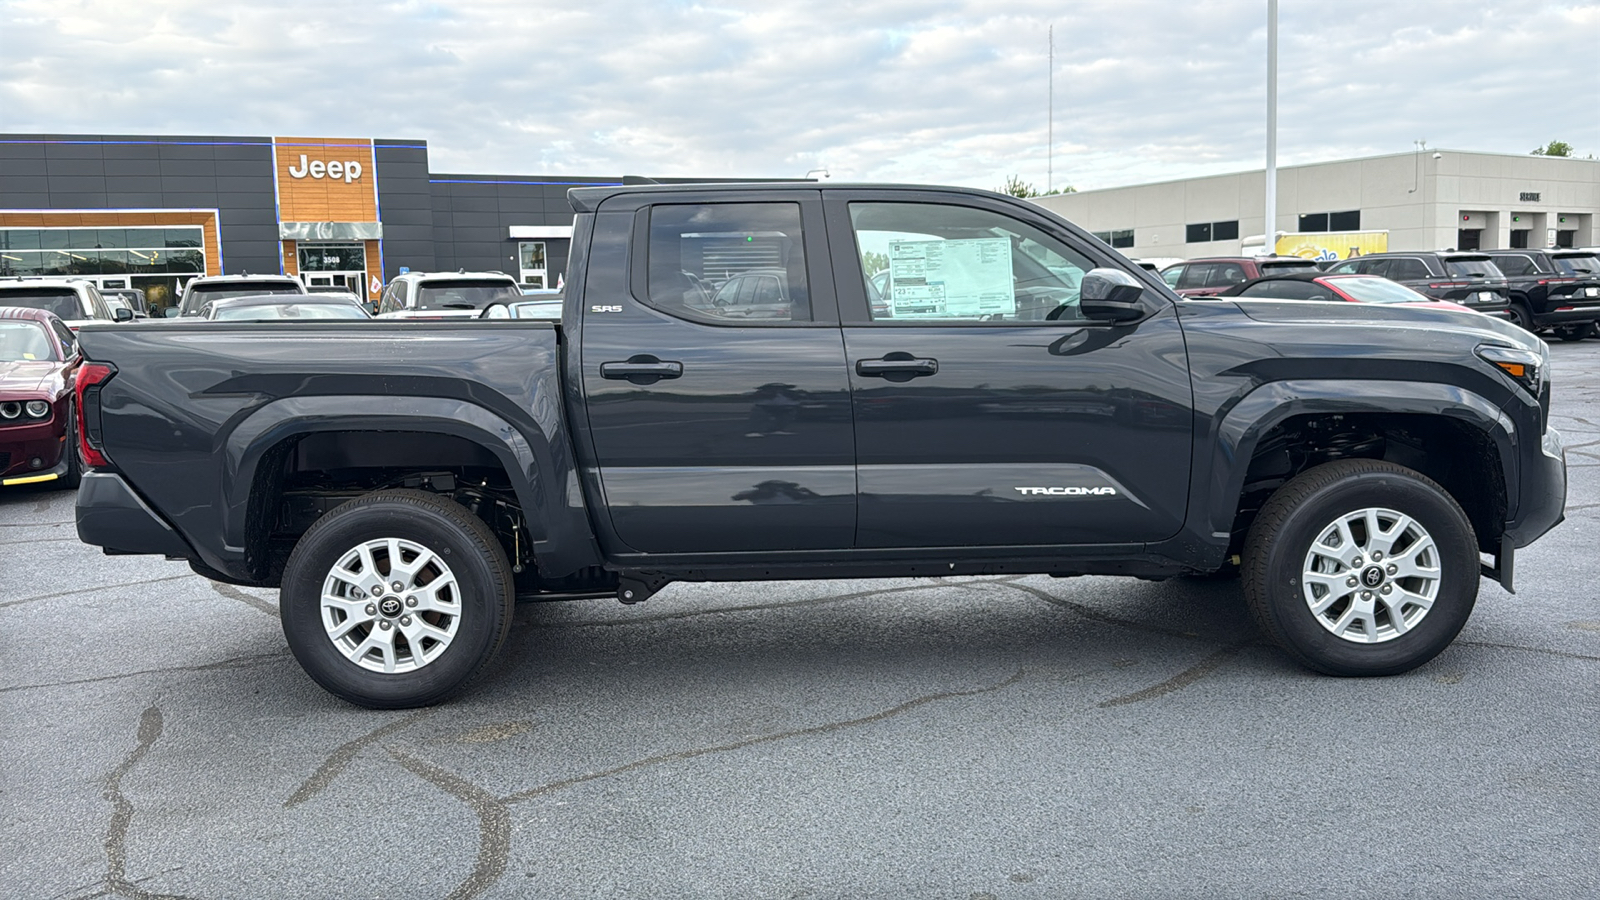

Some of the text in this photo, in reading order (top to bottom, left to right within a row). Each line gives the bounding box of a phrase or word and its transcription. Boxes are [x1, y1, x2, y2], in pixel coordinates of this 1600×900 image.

[289, 154, 362, 184] Jeep
[323, 256, 341, 264] 3508
[591, 305, 623, 313] SR5
[1014, 486, 1116, 496] TACOMA
